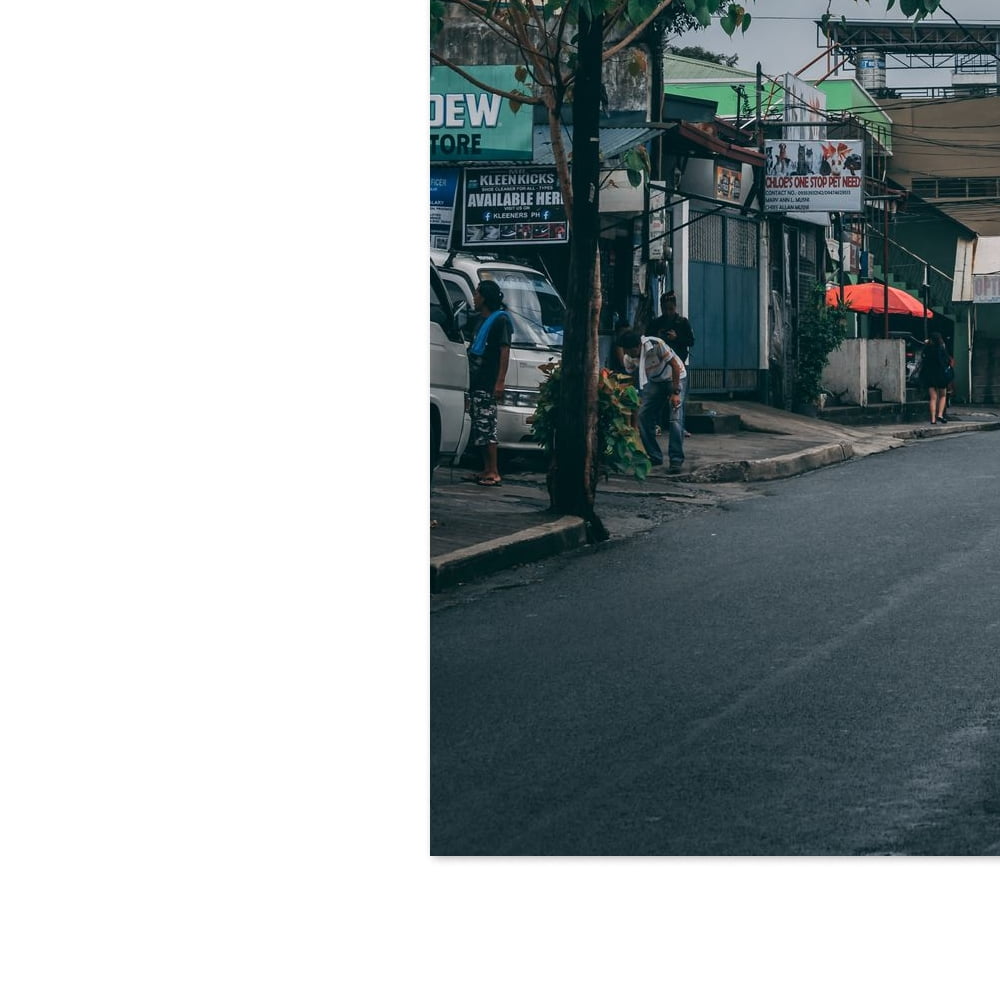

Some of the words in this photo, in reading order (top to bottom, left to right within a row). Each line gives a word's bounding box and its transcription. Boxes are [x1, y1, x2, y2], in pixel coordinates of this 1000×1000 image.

[794, 176, 809, 188] ONE
[810, 176, 827, 188] STOP
[828, 176, 841, 188] PET
[467, 191, 534, 207] AVAILABLE
